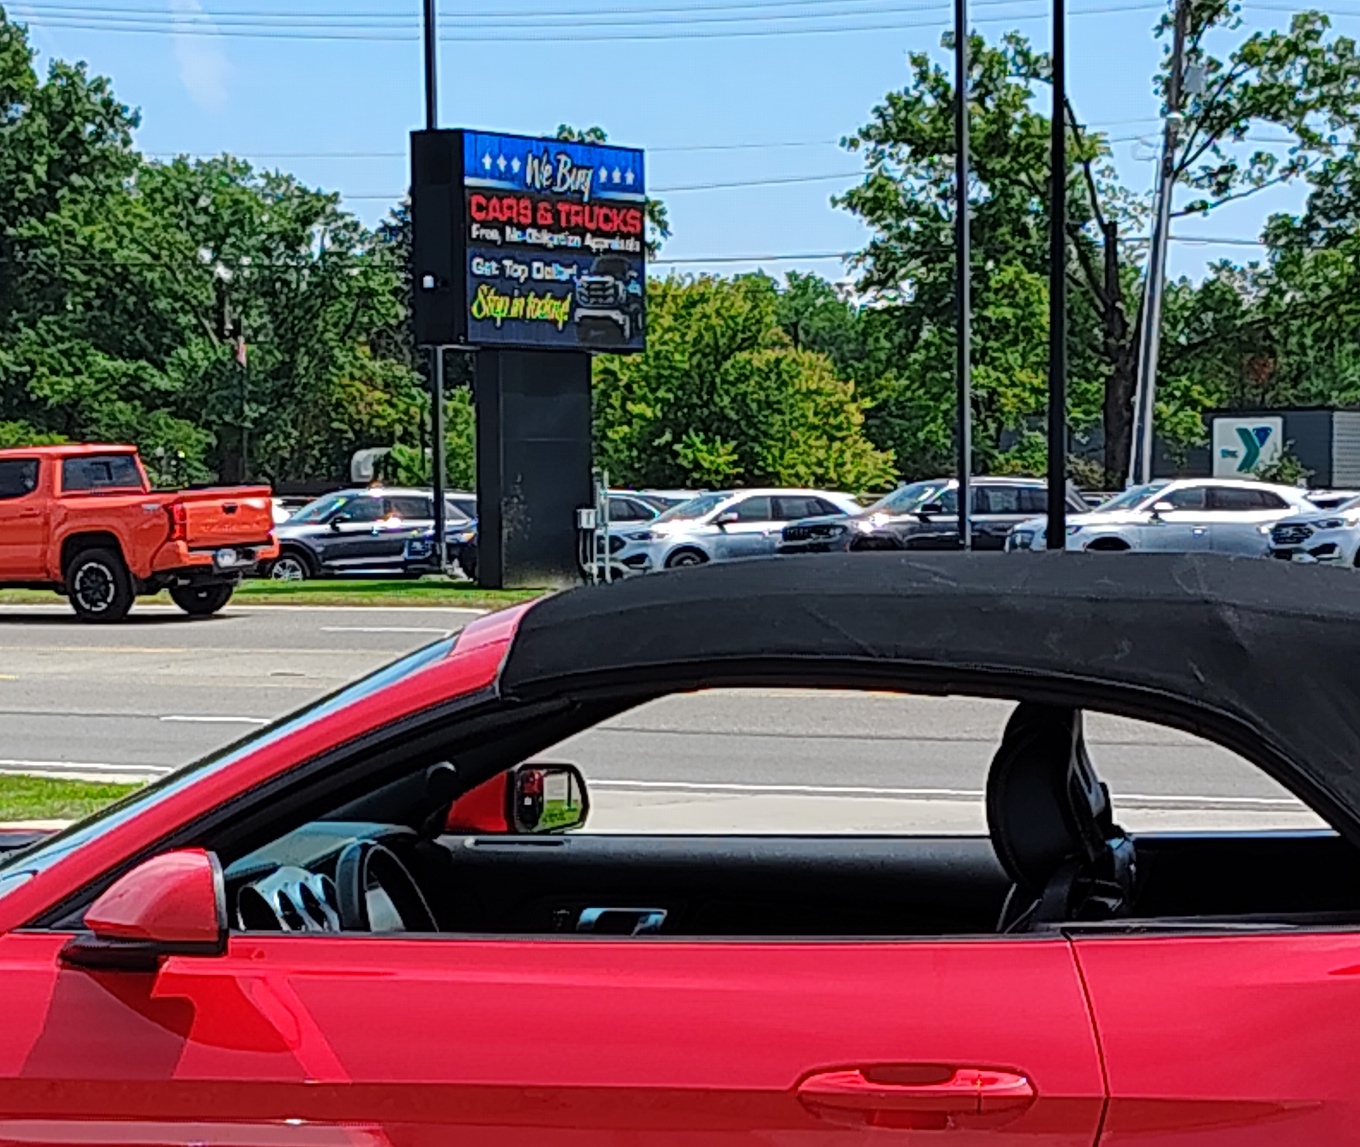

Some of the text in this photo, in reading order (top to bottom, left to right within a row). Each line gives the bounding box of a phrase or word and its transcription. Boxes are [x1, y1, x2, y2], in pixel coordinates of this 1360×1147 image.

[526, 152, 593, 202] We Buy
[470, 194, 642, 234] CARS & TRUCKS
[471, 223, 501, 245] Free,
[471, 257, 500, 276] Get
[502, 259, 529, 283] Top
